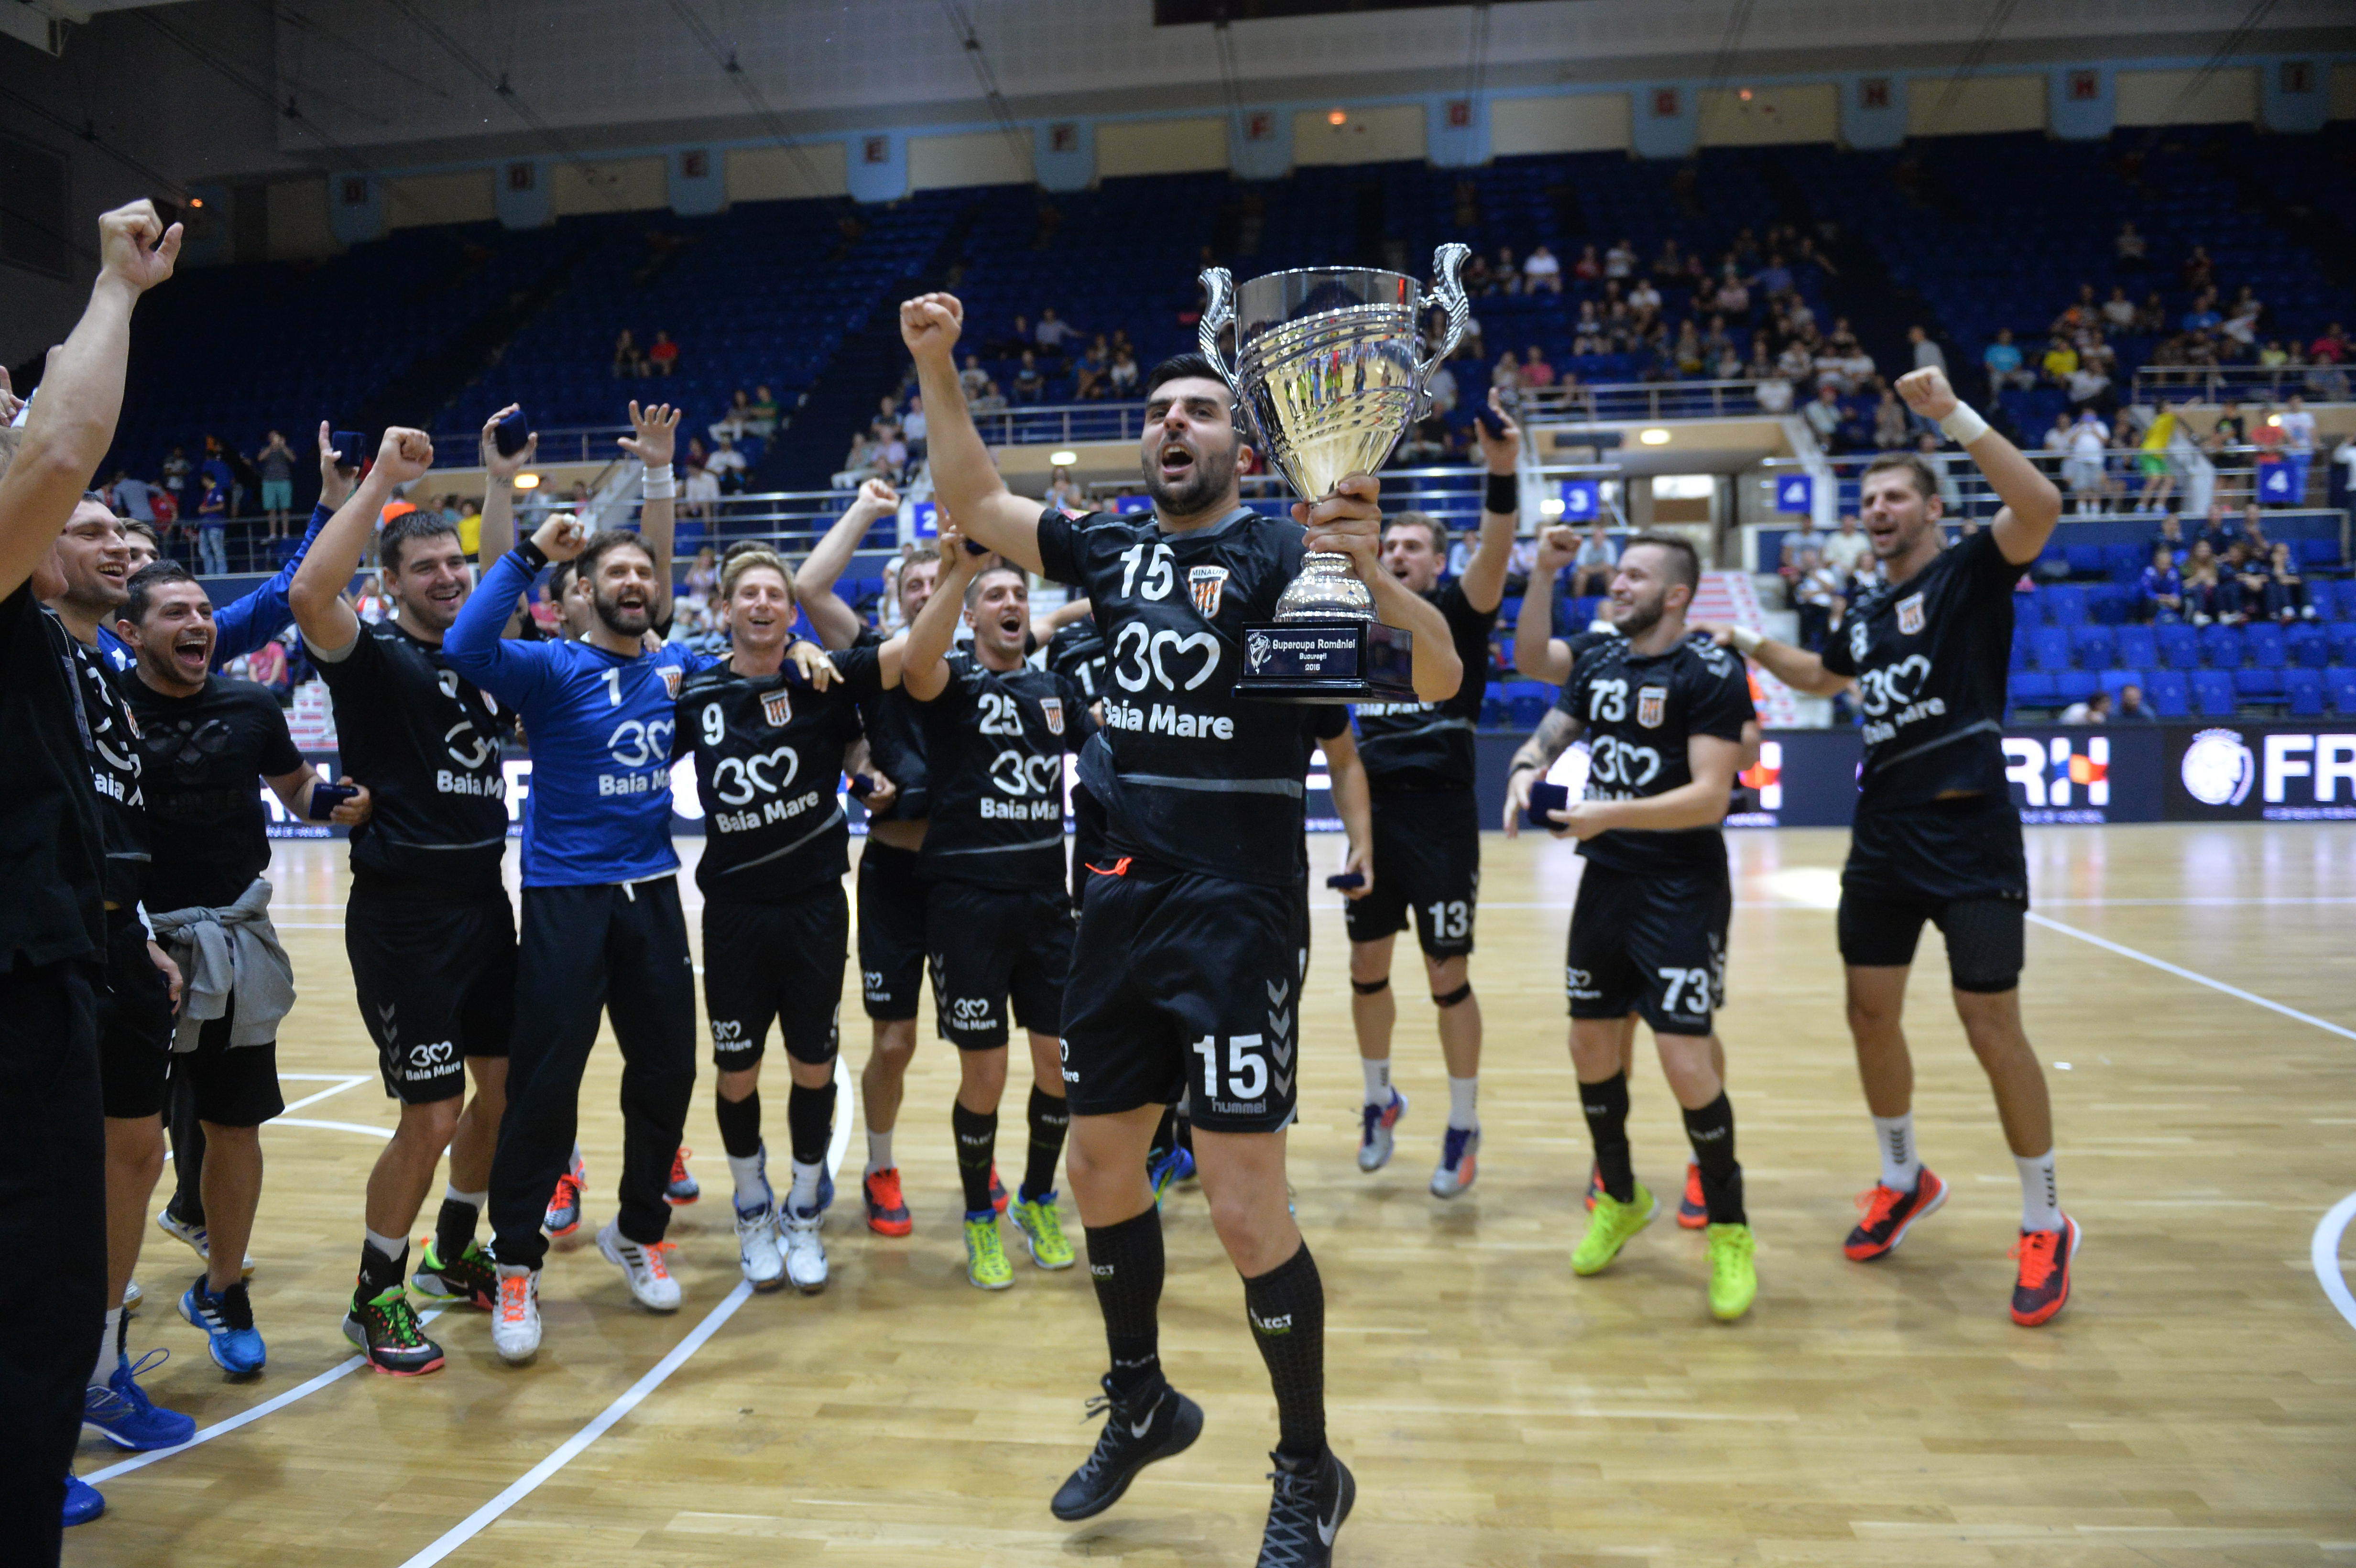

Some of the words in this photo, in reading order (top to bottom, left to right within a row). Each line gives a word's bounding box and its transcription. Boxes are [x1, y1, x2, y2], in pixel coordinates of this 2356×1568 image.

[1568, 489, 1588, 513] 3
[922, 510, 938, 532] 2
[1121, 543, 1175, 601] 15
[601, 666, 622, 707] 1
[1589, 678, 1629, 723] 73
[702, 702, 725, 746] 9
[978, 693, 1025, 737] 25
[1148, 703, 1235, 740] Mare
[436, 769, 483, 796] Baia
[599, 771, 649, 797] Baia
[715, 809, 762, 834] Baia
[764, 790, 819, 825] Mare
[980, 796, 1028, 821] Baia
[1428, 900, 1468, 938] 13
[1658, 967, 1710, 1014] 73
[1192, 1033, 1268, 1100] 15
[1211, 1097, 1266, 1114] hummel
